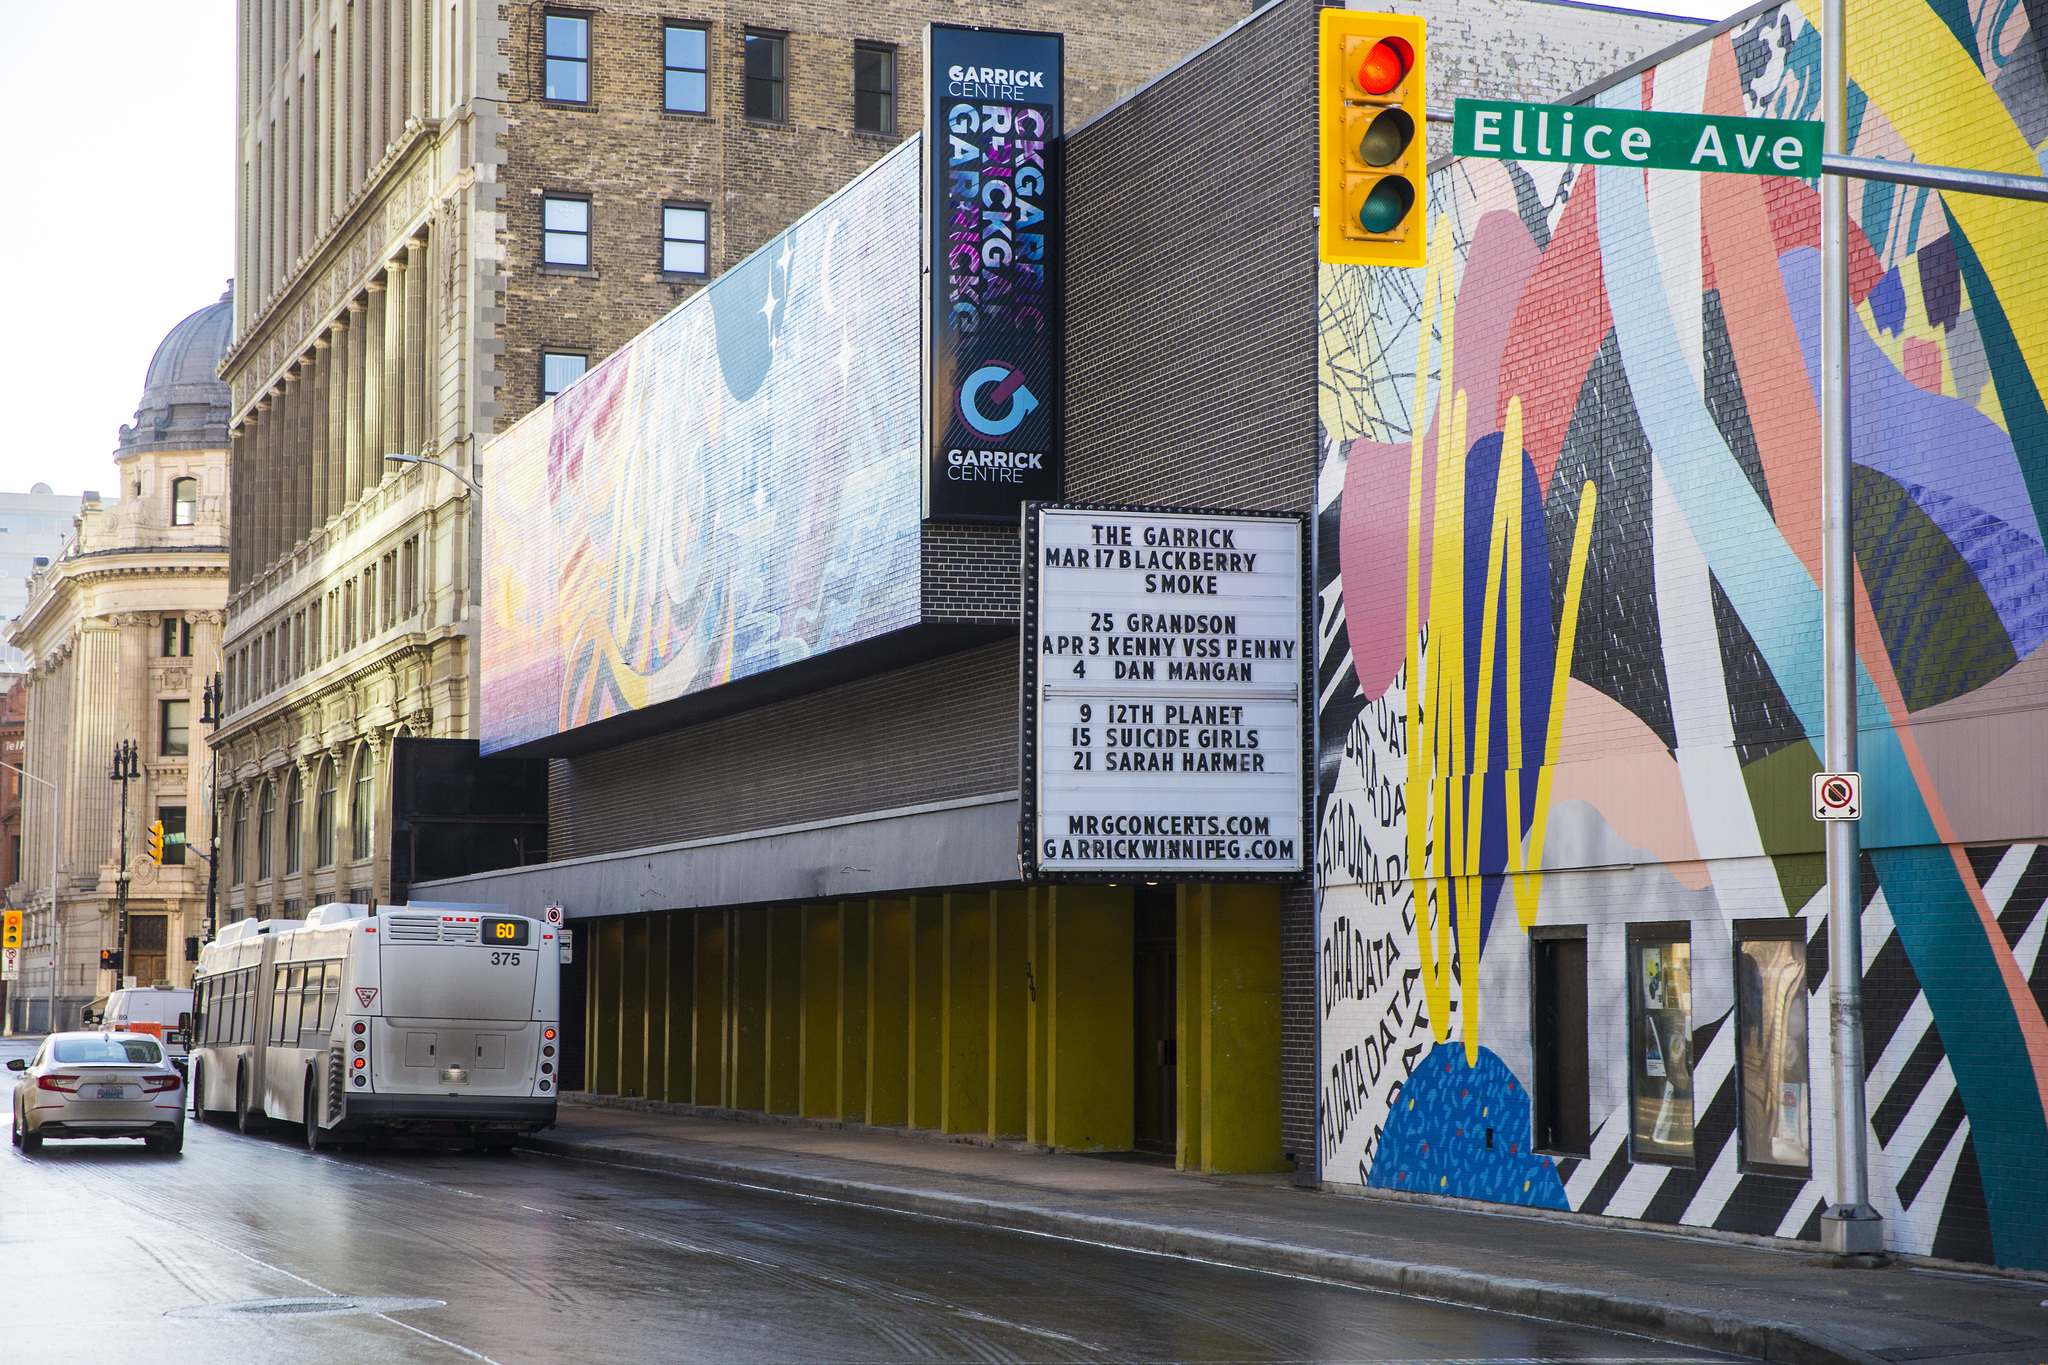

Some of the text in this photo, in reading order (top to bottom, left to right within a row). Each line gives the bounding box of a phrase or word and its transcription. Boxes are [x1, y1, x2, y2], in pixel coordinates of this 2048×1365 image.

[948, 65, 1043, 88] GARRICK
[948, 81, 1024, 101] CENTRE
[1474, 110, 1803, 170] Ellice Ave
[948, 449, 1042, 469] GARRICK
[948, 465, 1024, 483] CENTRE
[1092, 525, 1234, 548] THE GARRICK
[1046, 548, 1256, 572] MAR 17 BLACKBERRY
[1146, 575, 1217, 594] SMOKE
[1091, 612, 1235, 634] 25 GRANDSON
[1043, 636, 1294, 659] APR 3 KENNY VSS PENNY
[1073, 660, 1251, 682] 4 DAN MANGAN
[1080, 704, 1242, 725] 9 12TH PLANET
[1073, 727, 1258, 749] 15 SUICIDE GIRLS
[1074, 752, 1264, 772] 21 SARAH HARMER
[1069, 815, 1269, 836] MRGCONCERTS.COM
[1044, 839, 1293, 859] GARRICKWINNIPEG.COM
[496, 922, 515, 939] 60
[491, 951, 520, 967] 375
